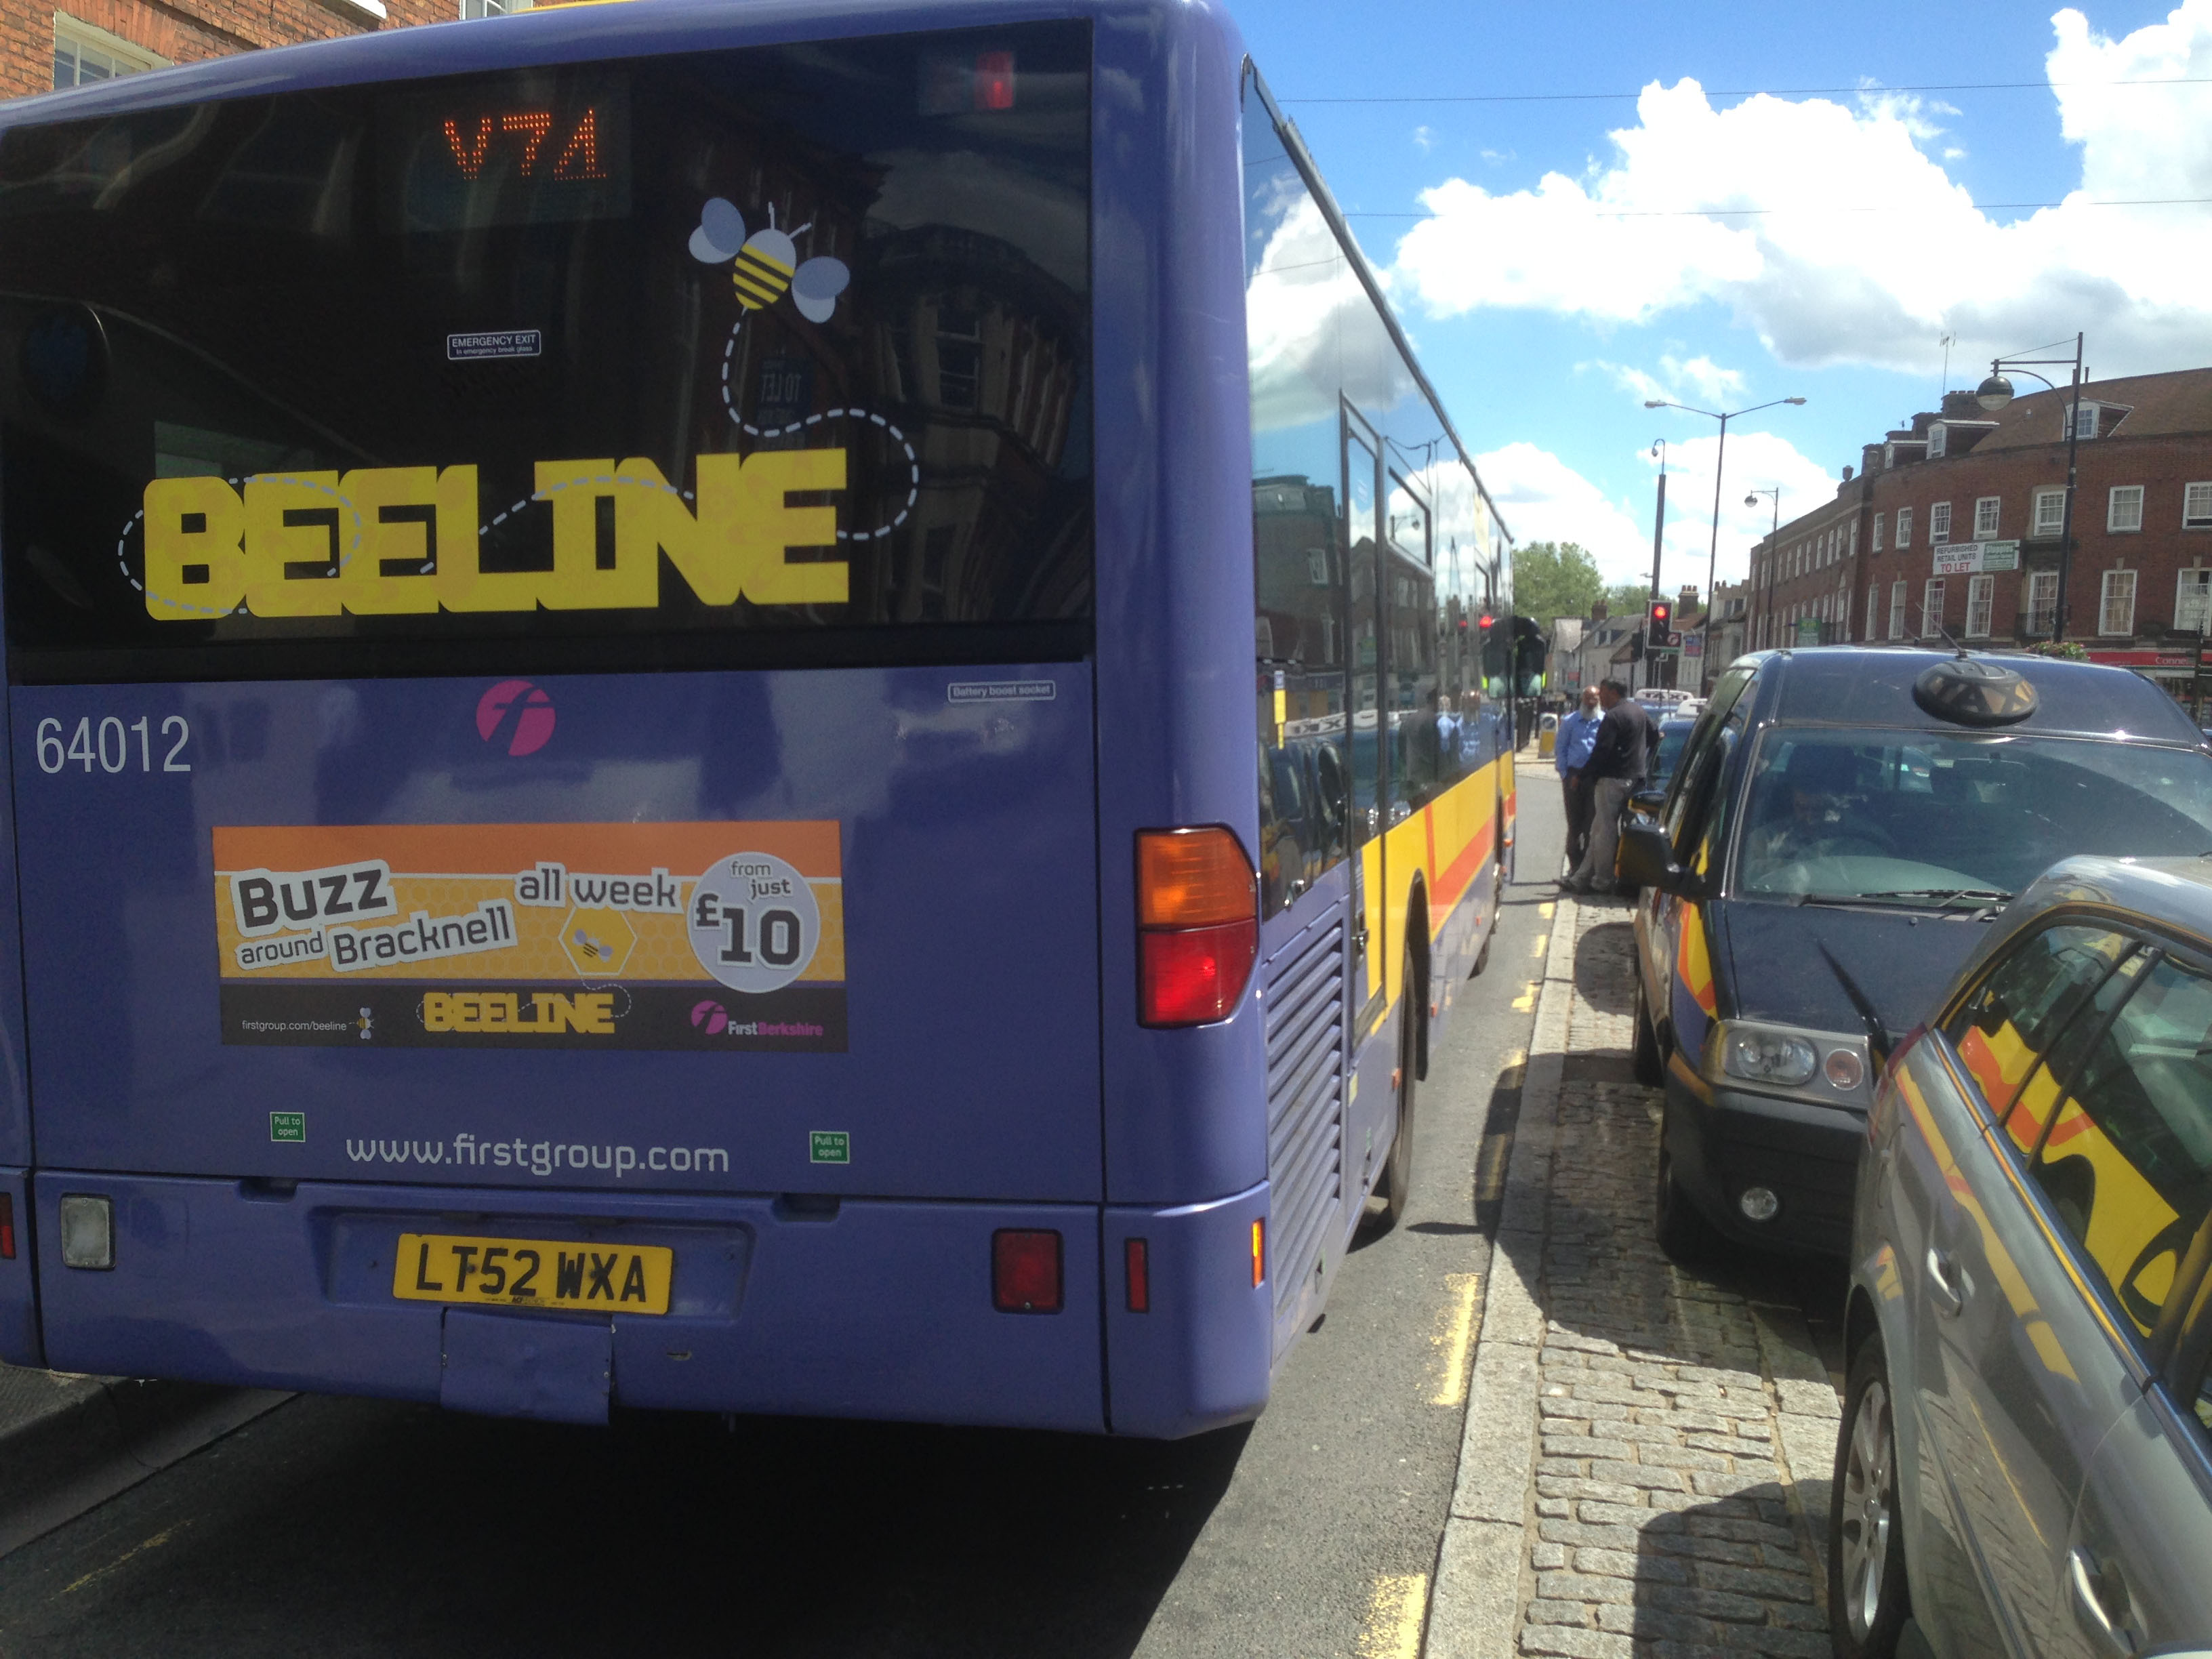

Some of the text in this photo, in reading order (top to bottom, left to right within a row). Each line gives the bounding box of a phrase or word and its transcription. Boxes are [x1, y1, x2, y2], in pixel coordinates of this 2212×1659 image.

[452, 334, 536, 348] EMERGENCY EXIT
[143, 448, 849, 621] BEELINE
[1936, 544, 1978, 555] REFURBISHED
[1937, 554, 1957, 562] RETAIL
[1957, 553, 1977, 562] UNITS
[1940, 562, 1971, 573] TO LET
[953, 687, 987, 699] Battery
[1019, 683, 1051, 695] socket
[36, 715, 192, 774] 64012
[731, 861, 771, 876] from
[750, 878, 792, 901] just
[238, 867, 676, 928] Buzz all week
[241, 905, 511, 965] around Bracknell
[423, 991, 615, 1033] BEELINE
[241, 1019, 347, 1033] firstgroup.com/beeline
[274, 1116, 301, 1126] Pull to
[277, 1128, 299, 1137] open
[815, 1135, 845, 1146] Pull to
[345, 1133, 729, 1178] www.firstgroup.com
[818, 1149, 842, 1158] open
[415, 1242, 647, 1303] LT52 WXA
